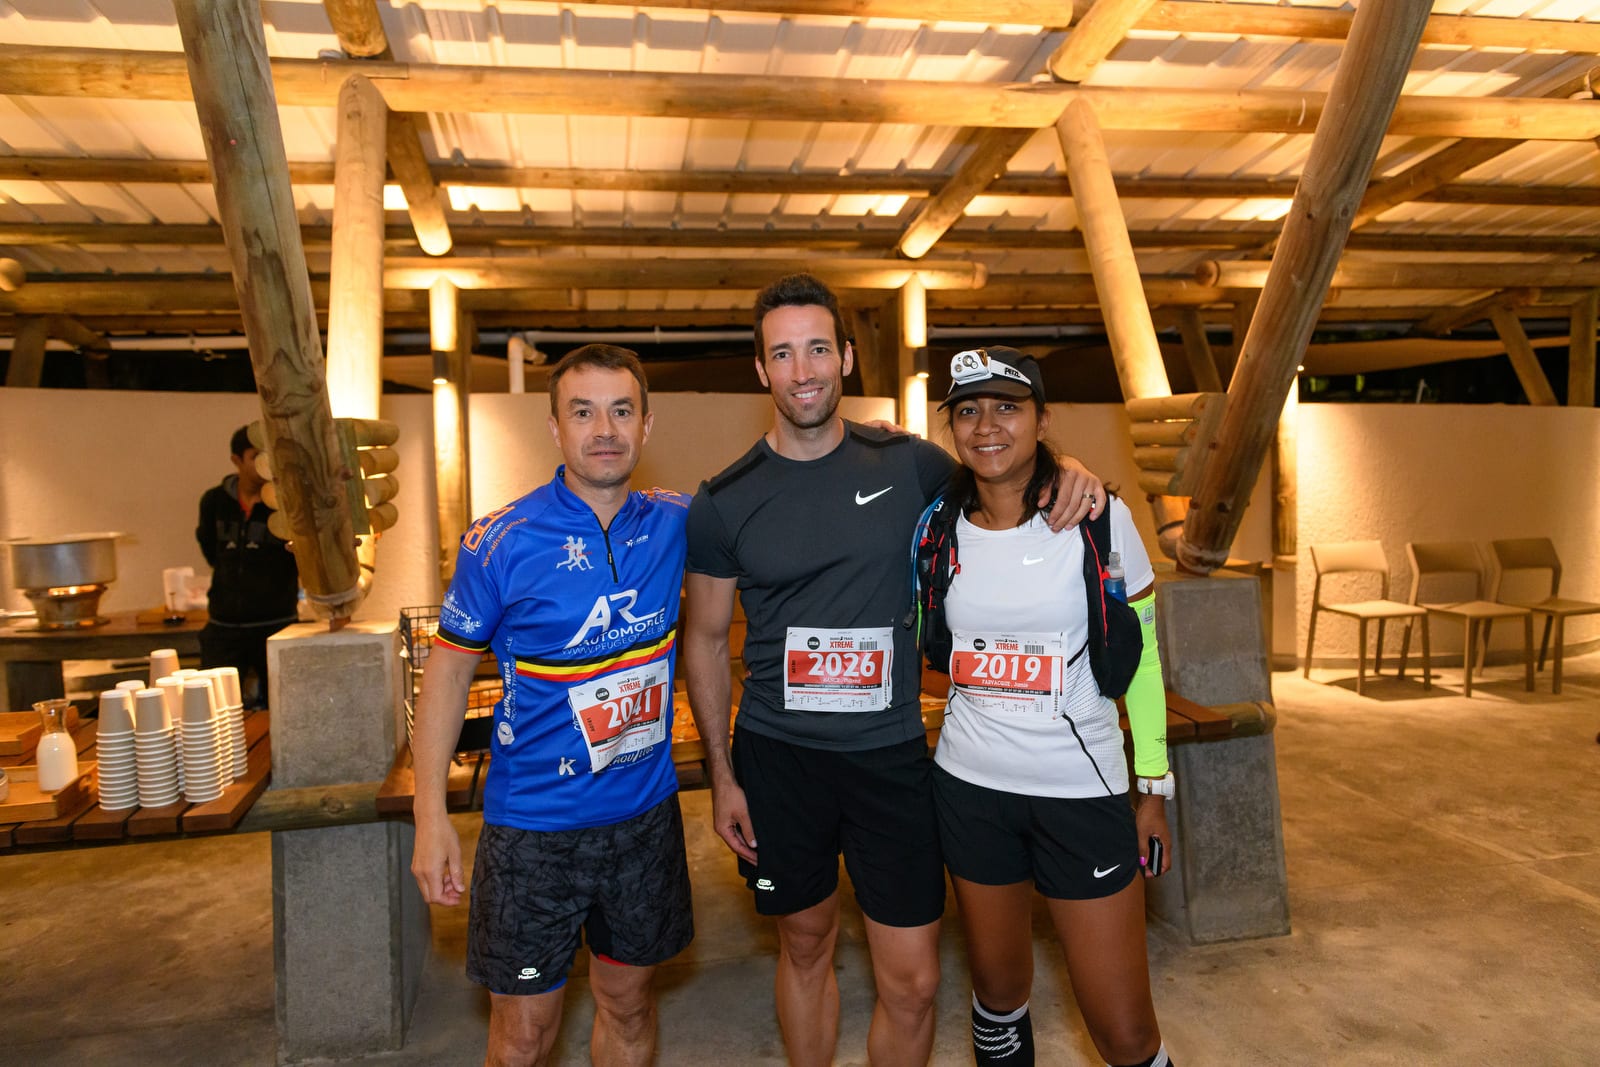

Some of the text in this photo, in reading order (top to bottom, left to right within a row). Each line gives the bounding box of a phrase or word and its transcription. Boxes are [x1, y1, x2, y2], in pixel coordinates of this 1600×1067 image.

[579, 612, 666, 647] AUTOMOLE
[829, 641, 854, 649] XTREME
[995, 642, 1019, 651] XTREME
[807, 652, 876, 677] 2026
[971, 653, 1042, 682] 2019
[619, 681, 641, 693] XTREME
[602, 688, 652, 729] 2041
